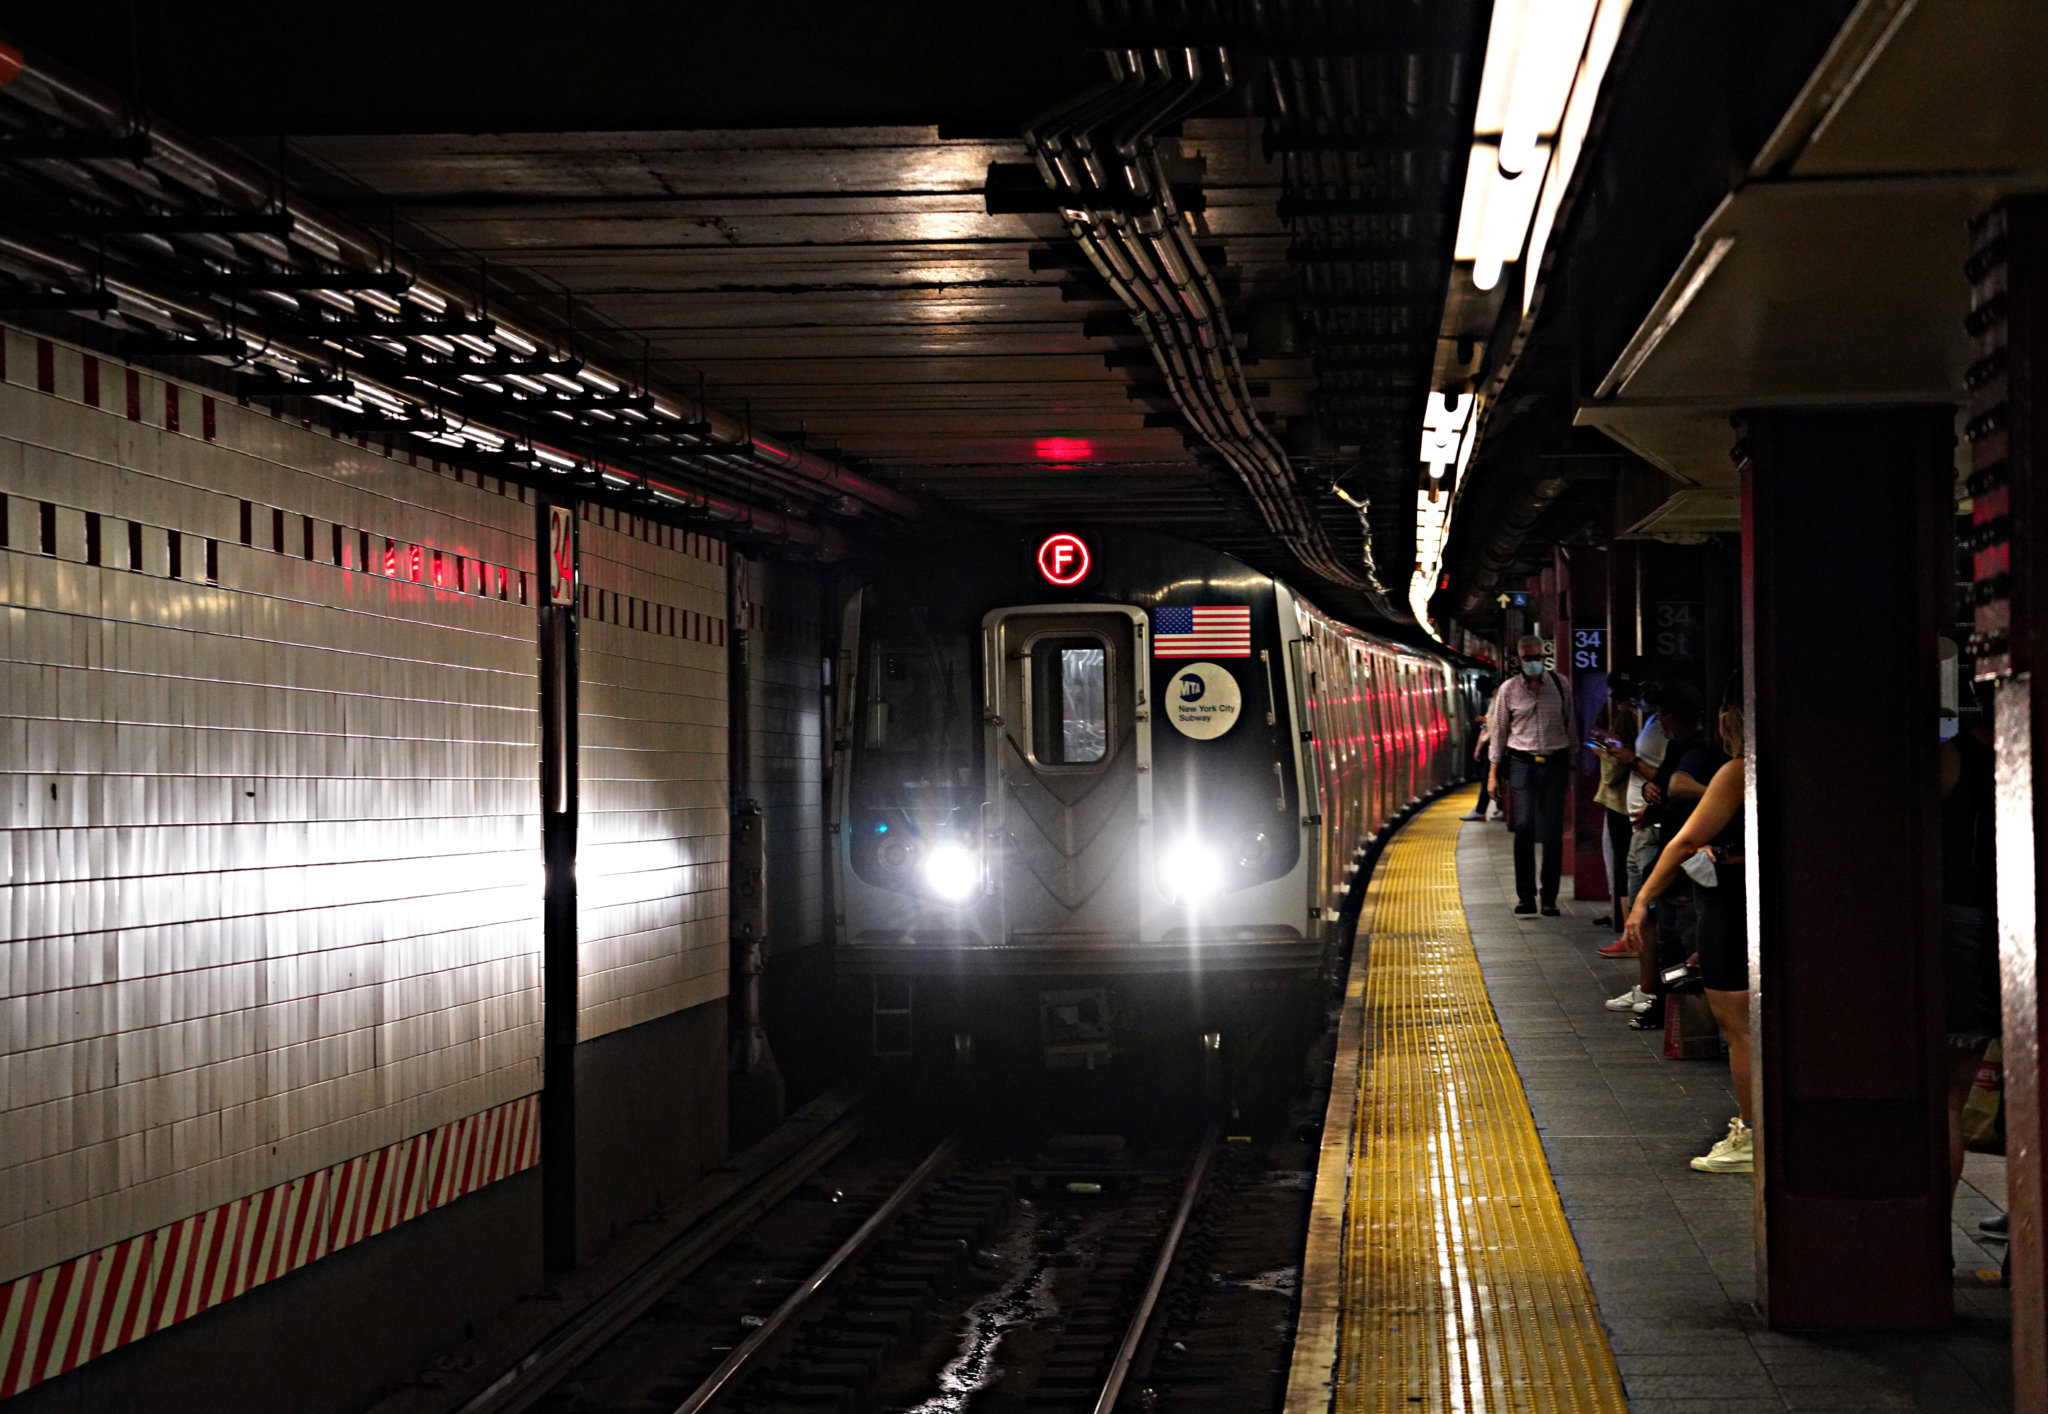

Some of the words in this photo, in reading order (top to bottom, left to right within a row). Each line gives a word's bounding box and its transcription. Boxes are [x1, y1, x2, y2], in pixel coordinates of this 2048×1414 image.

[551, 510, 573, 600] 34
[1055, 545, 1074, 574] F
[1657, 604, 1691, 628] 34
[1542, 641, 1554, 655] 3
[1574, 631, 1601, 648] 34
[1657, 632, 1689, 656] St
[1543, 656, 1555, 671] S
[1574, 650, 1599, 668] St
[1180, 680, 1201, 697] MTA
[1219, 704, 1235, 713] City
[1179, 714, 1211, 722] Subway
